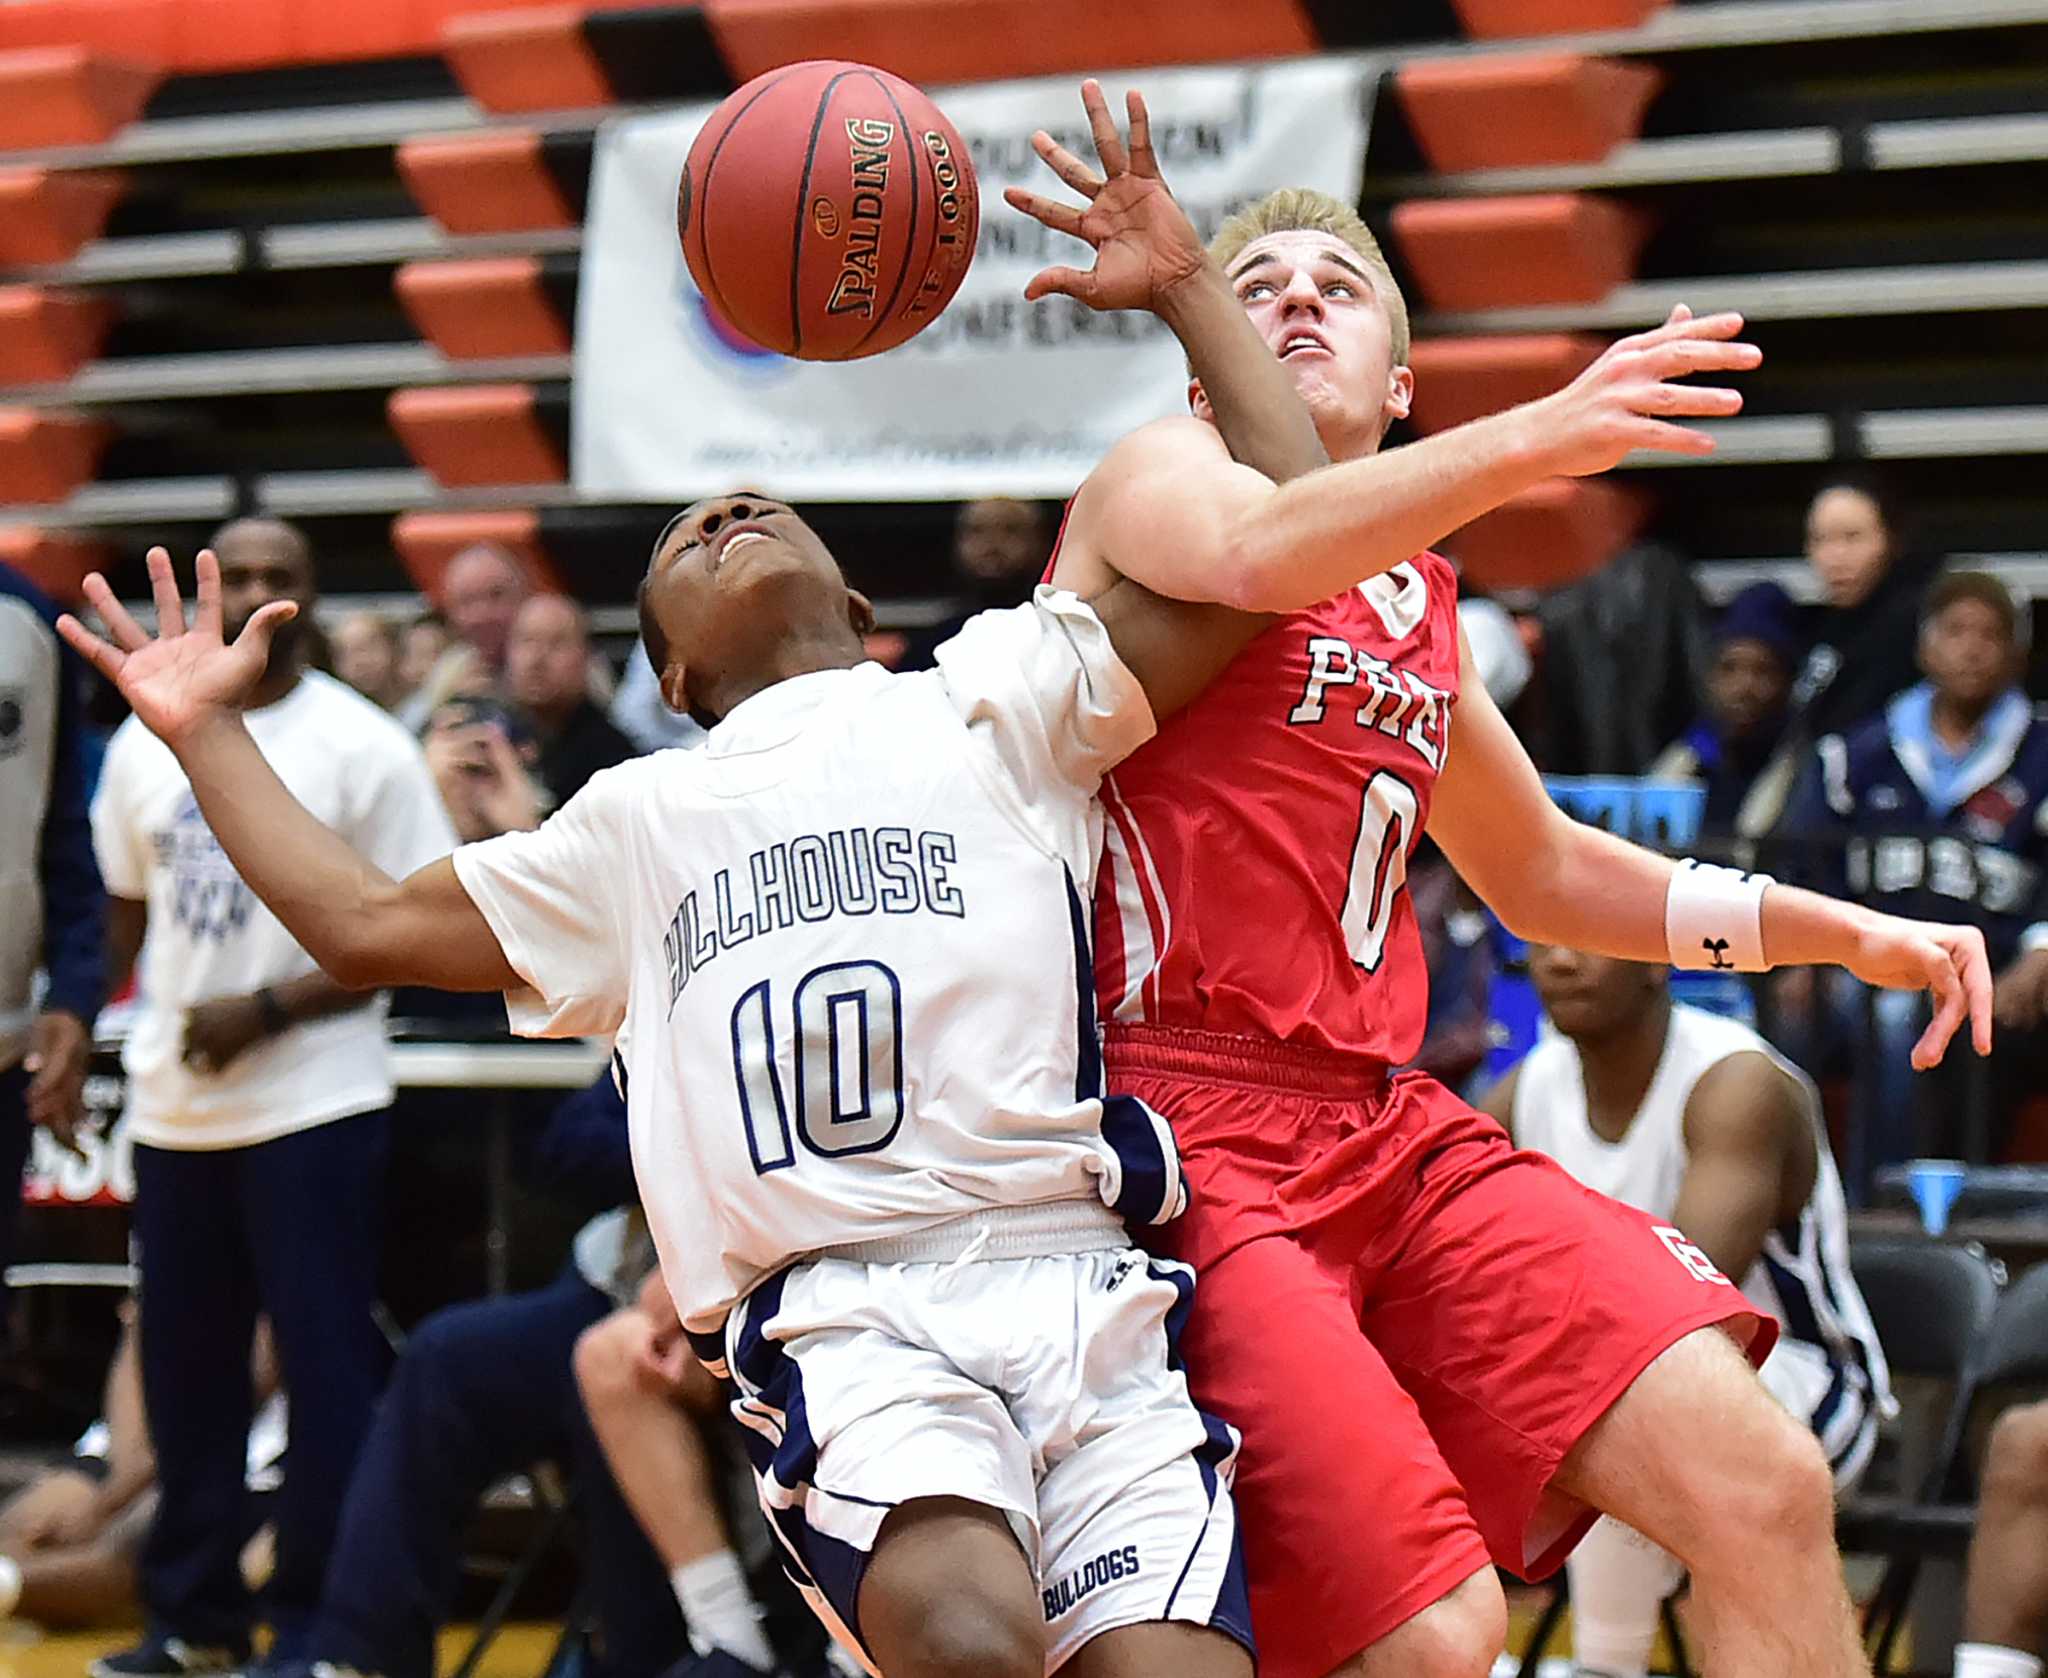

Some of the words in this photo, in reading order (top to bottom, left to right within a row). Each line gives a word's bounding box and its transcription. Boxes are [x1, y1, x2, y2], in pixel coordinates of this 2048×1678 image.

[825, 118, 894, 319] SPALDING
[663, 828, 965, 1020] HILLHOUSE
[1341, 769, 1418, 975] 0
[731, 959, 904, 1176] 10
[1041, 1545, 1139, 1622] BULLDOGS
